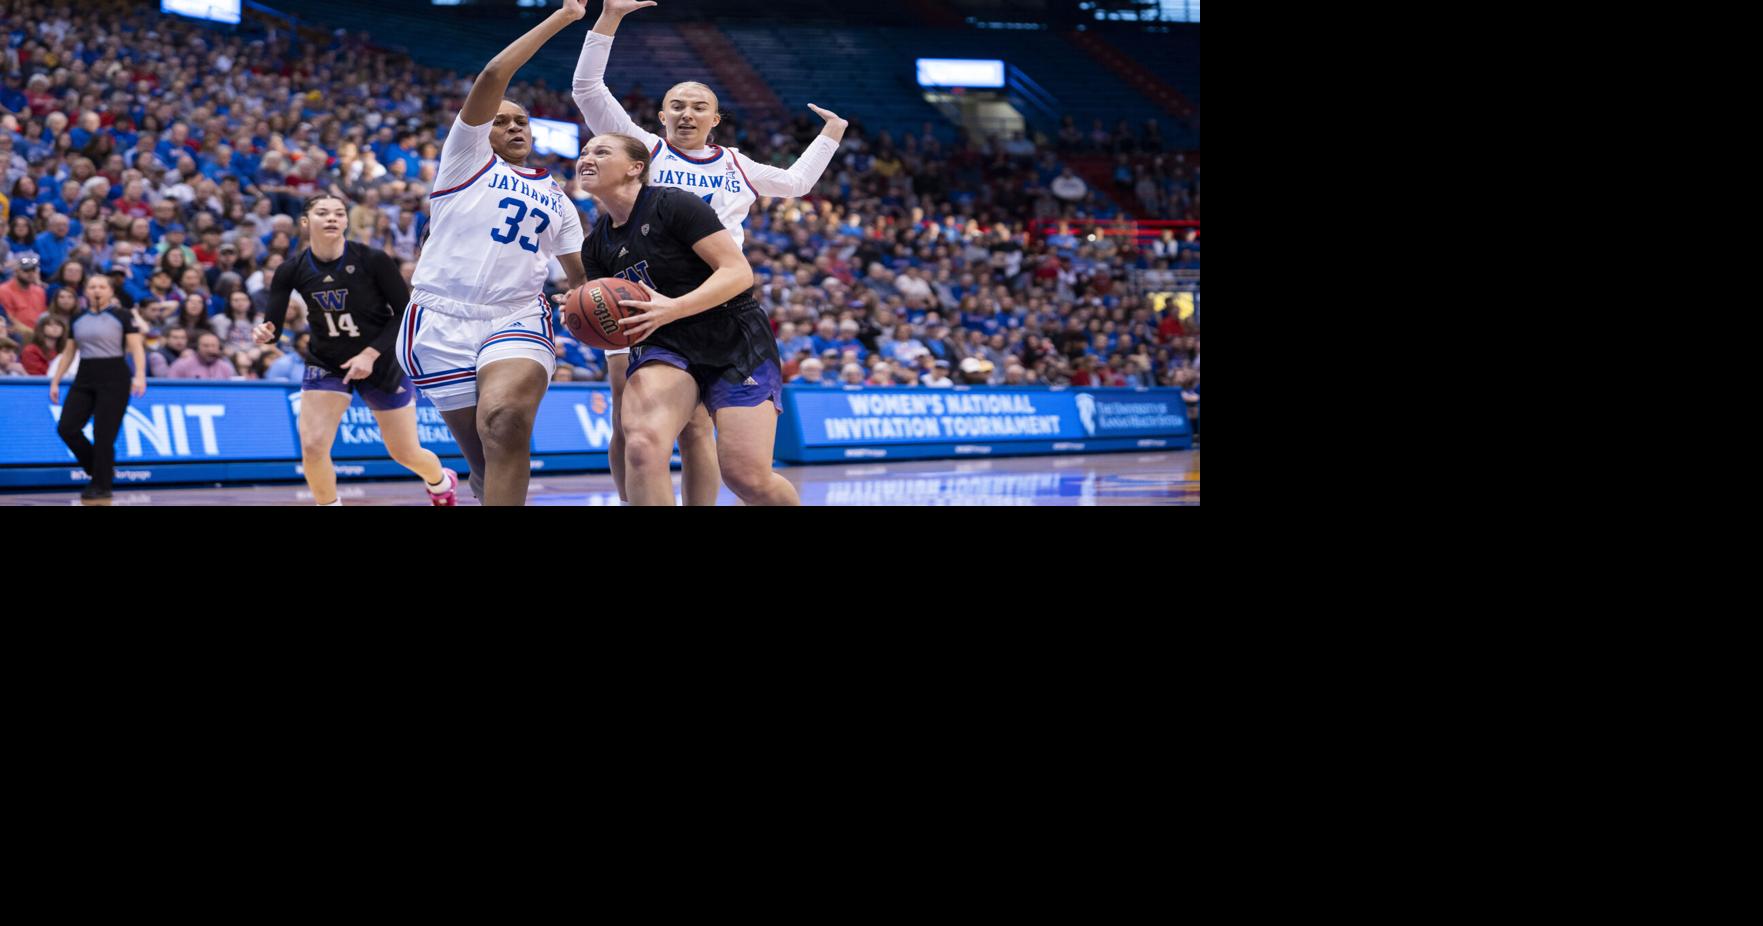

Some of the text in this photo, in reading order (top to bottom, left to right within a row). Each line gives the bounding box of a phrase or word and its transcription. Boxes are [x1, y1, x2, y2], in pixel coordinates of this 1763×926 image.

[654, 169, 741, 193] JAYHAWKS
[490, 196, 551, 254] 33
[311, 288, 349, 312] W
[588, 286, 620, 335] Wilson
[323, 312, 360, 337] 14
[847, 394, 1036, 416] WOMEN'S NATIONAL
[824, 415, 1060, 440] INVITATION TOURNAMENT
